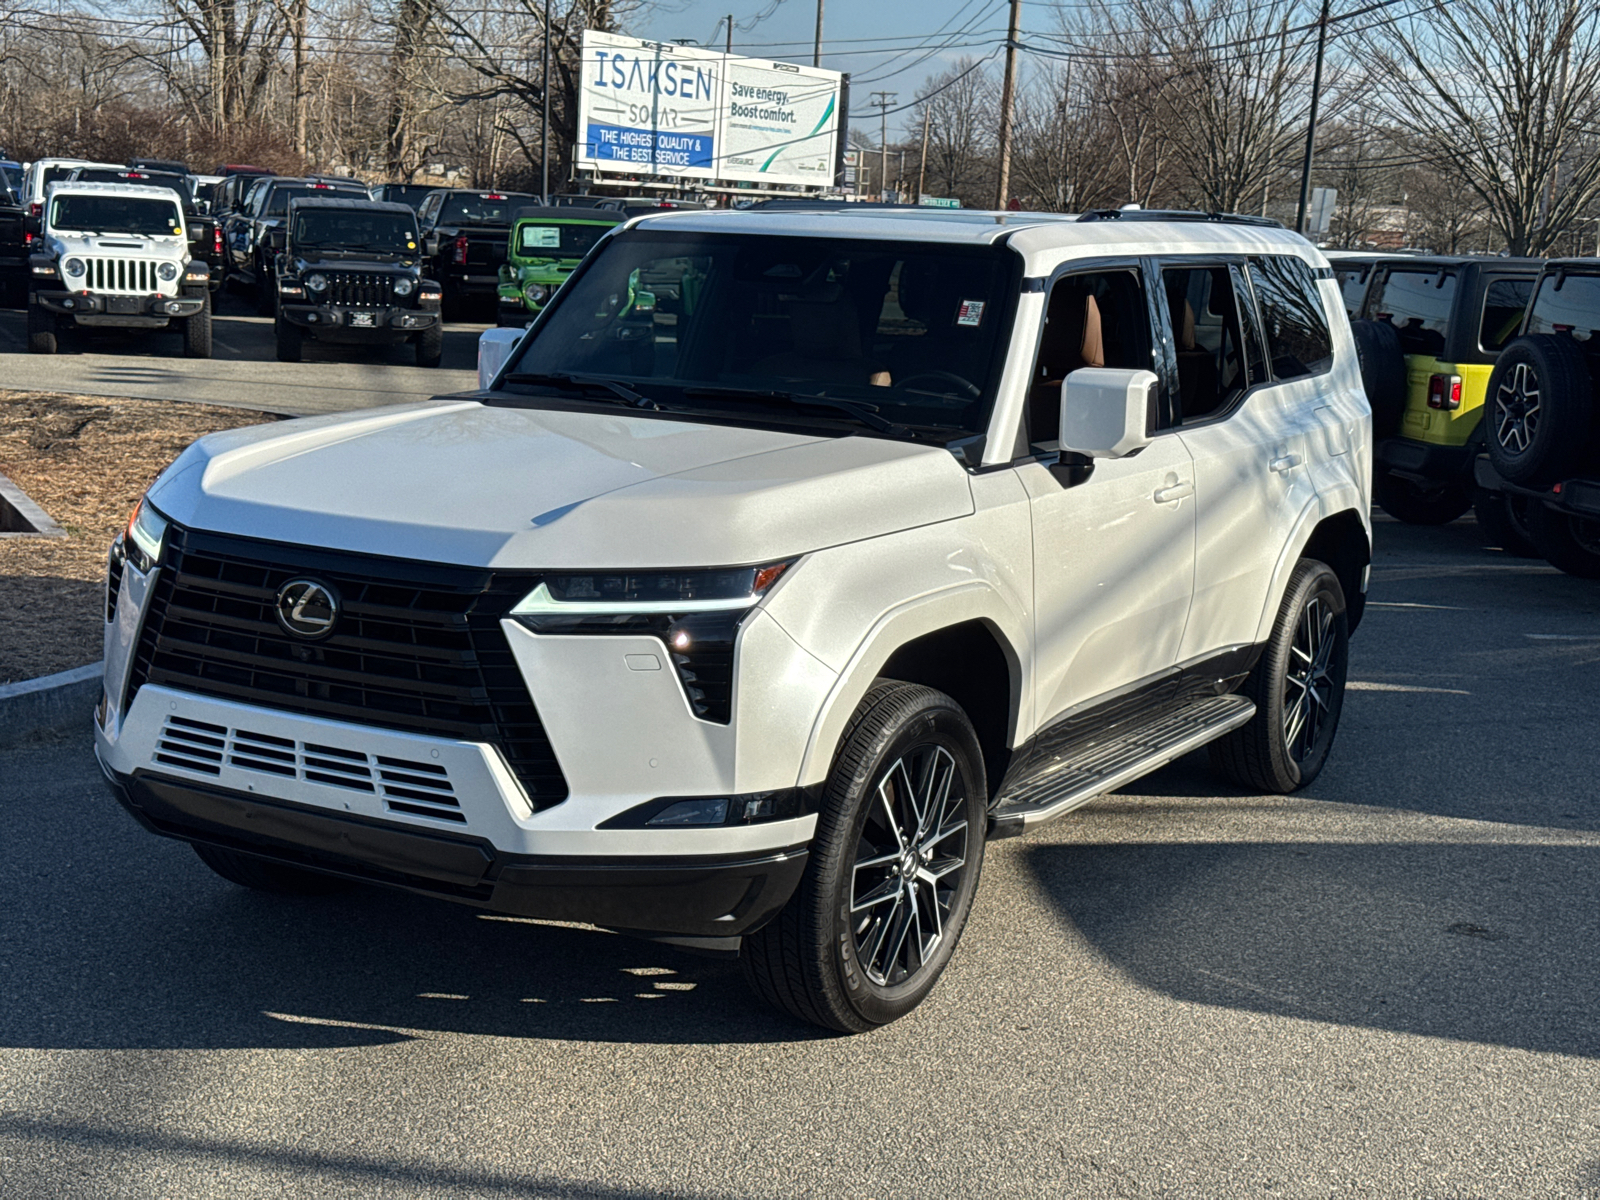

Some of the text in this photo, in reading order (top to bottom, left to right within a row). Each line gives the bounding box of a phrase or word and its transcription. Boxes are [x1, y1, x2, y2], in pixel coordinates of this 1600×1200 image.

[594, 51, 712, 101] ISAKSEN
[731, 82, 789, 106] Save energy.
[628, 103, 678, 127] SOAR
[731, 102, 797, 123] Boost comfort.
[600, 130, 618, 144] THE
[658, 135, 694, 151] QUALITY
[695, 139, 701, 152] &
[611, 146, 690, 165] THE BEST SERVICE
